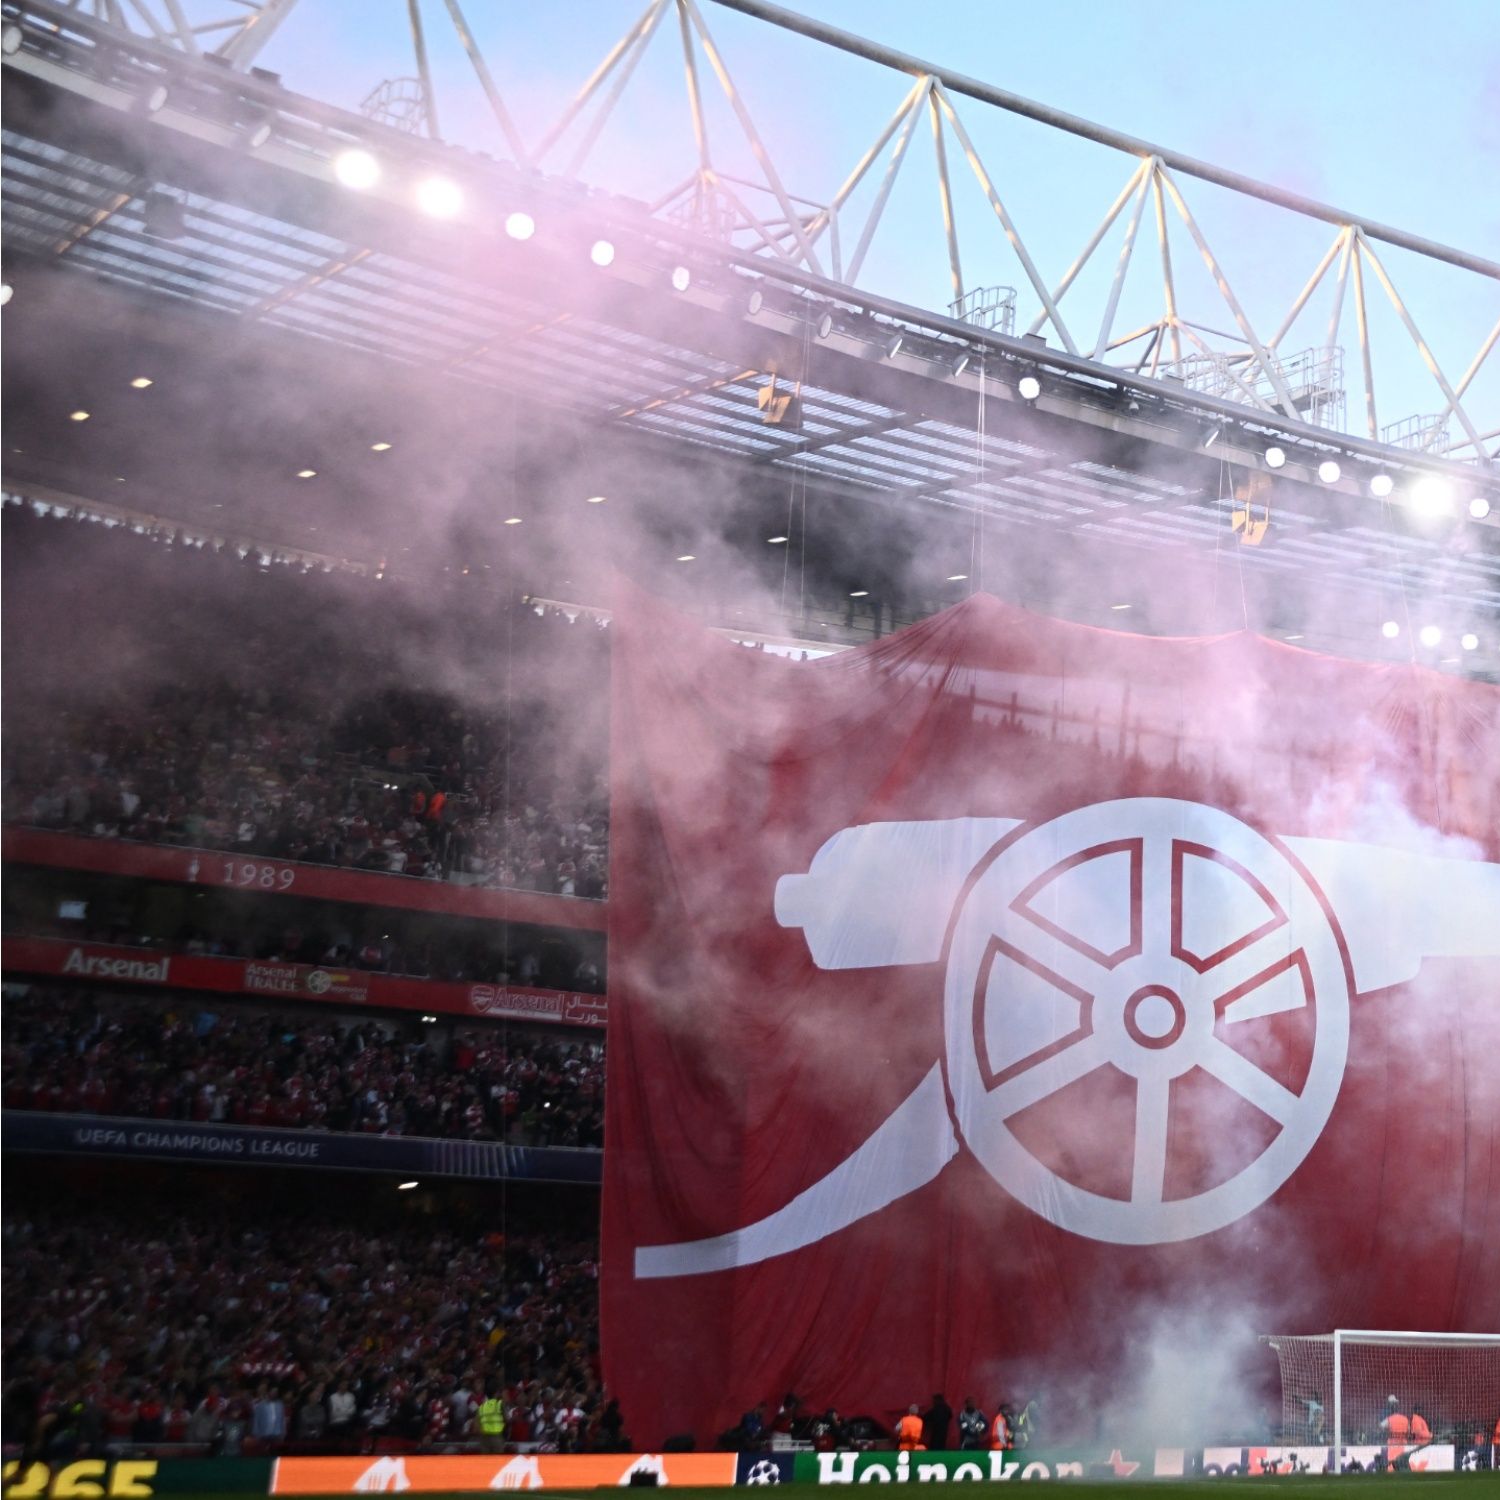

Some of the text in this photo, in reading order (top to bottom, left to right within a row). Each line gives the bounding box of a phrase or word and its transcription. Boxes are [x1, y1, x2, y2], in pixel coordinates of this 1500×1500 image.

[223, 862, 295, 889] 1989
[62, 947, 170, 982] Arsenal
[246, 962, 297, 978] Arsenal
[493, 987, 564, 1011] Arsenal
[77, 1128, 321, 1158] UEFA CHAMPIONS LEAGUE
